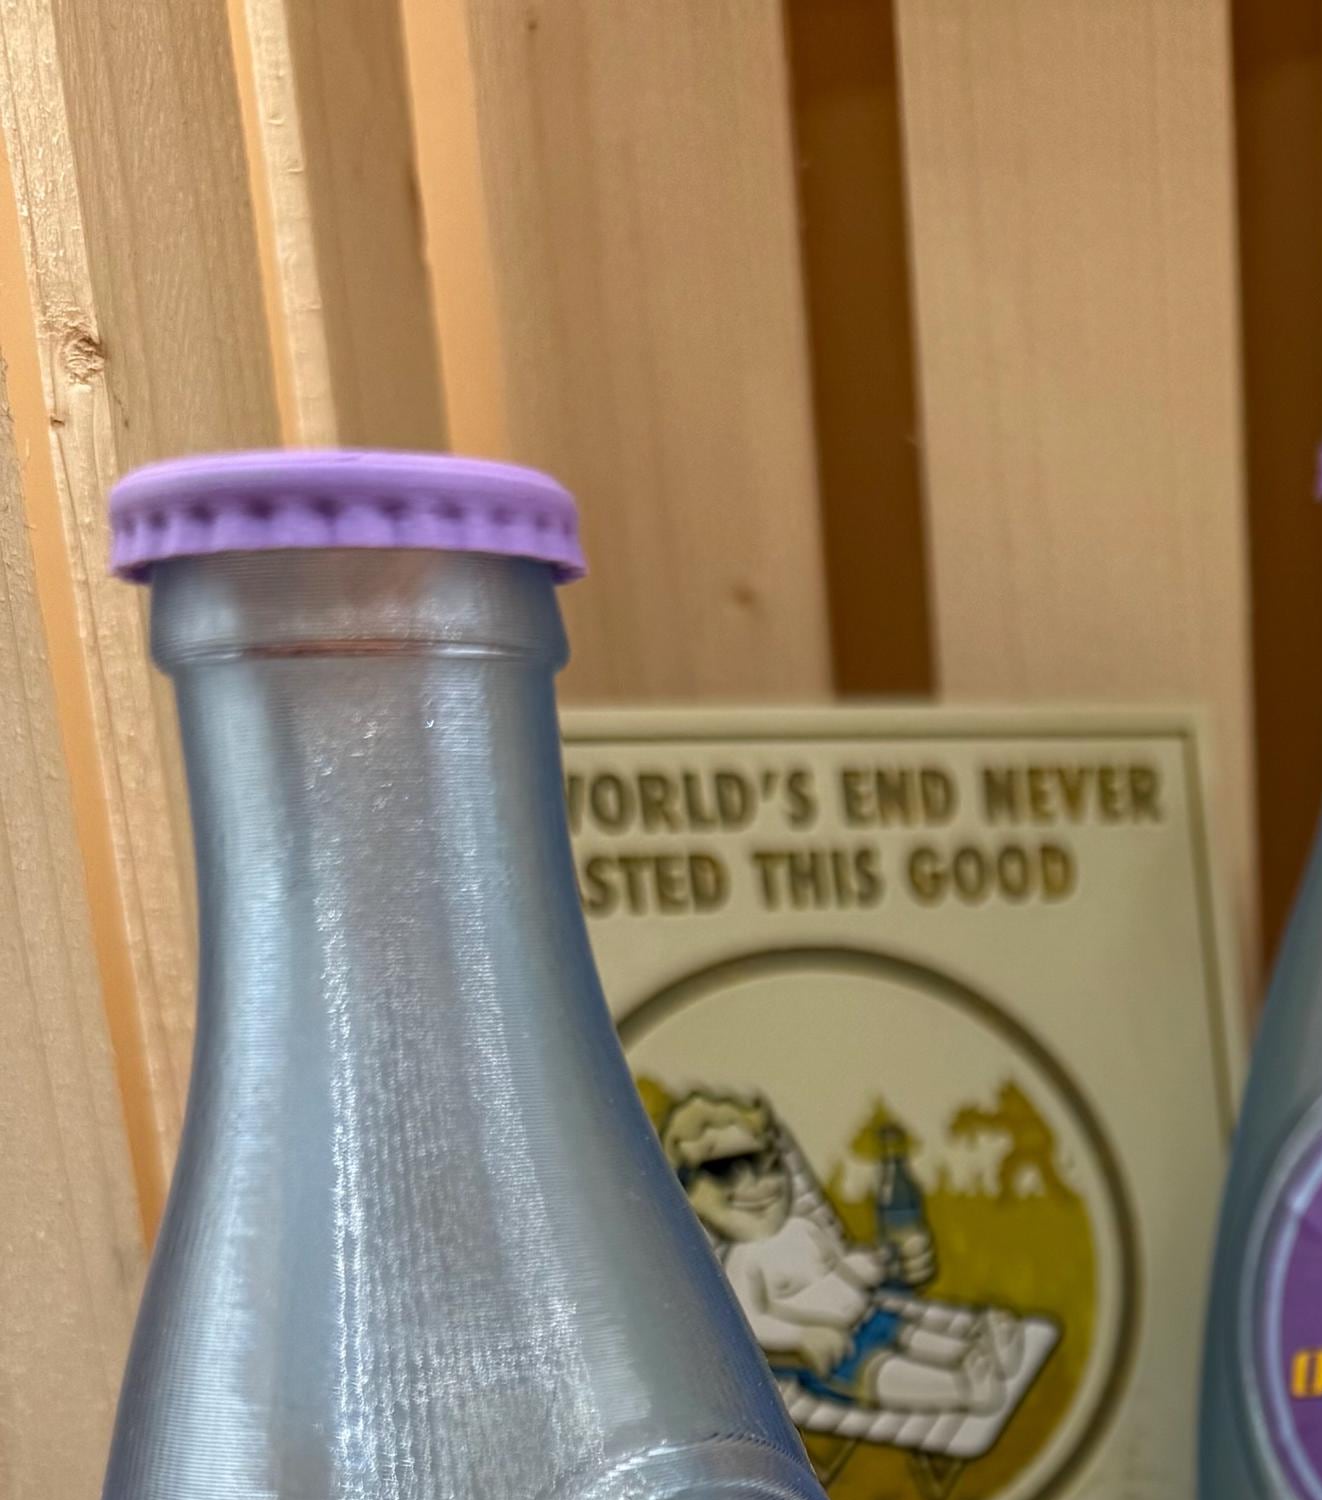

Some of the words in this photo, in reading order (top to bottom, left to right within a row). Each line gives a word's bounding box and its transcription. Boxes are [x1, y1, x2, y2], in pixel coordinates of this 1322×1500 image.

[840, 766, 960, 832] END
[980, 763, 1163, 827] NEVER
[583, 852, 731, 918] STED
[753, 848, 885, 912] THIS
[905, 842, 1078, 909] GOOD
